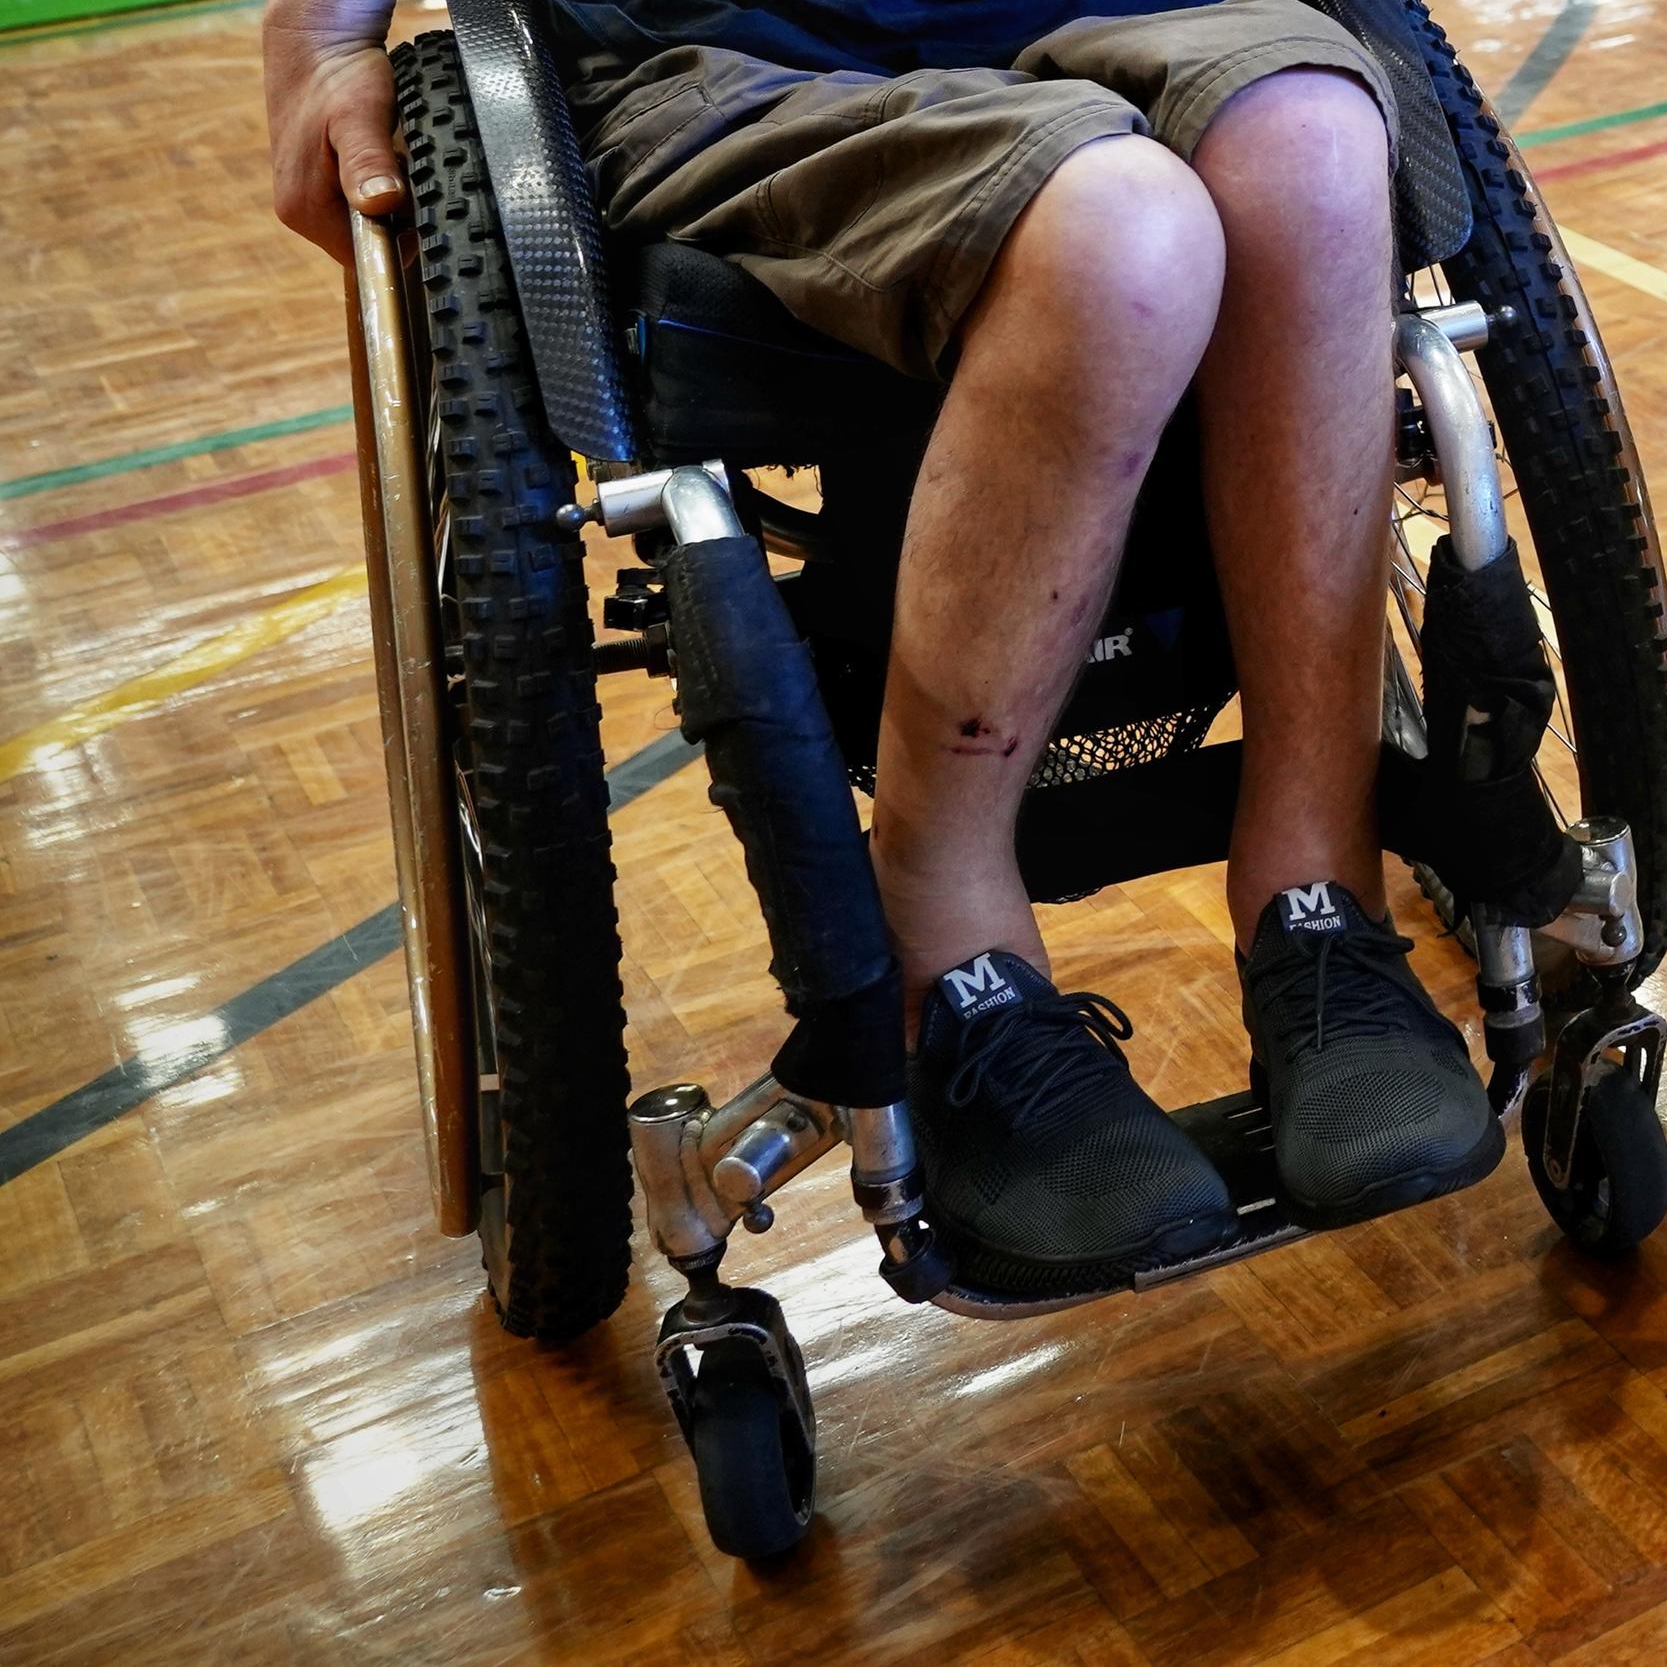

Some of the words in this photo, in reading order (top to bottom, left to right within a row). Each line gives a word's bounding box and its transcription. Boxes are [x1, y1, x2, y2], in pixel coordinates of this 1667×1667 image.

[1088, 634, 1133, 663] IR
[1281, 881, 1336, 921] M
[943, 952, 1006, 1009] M
